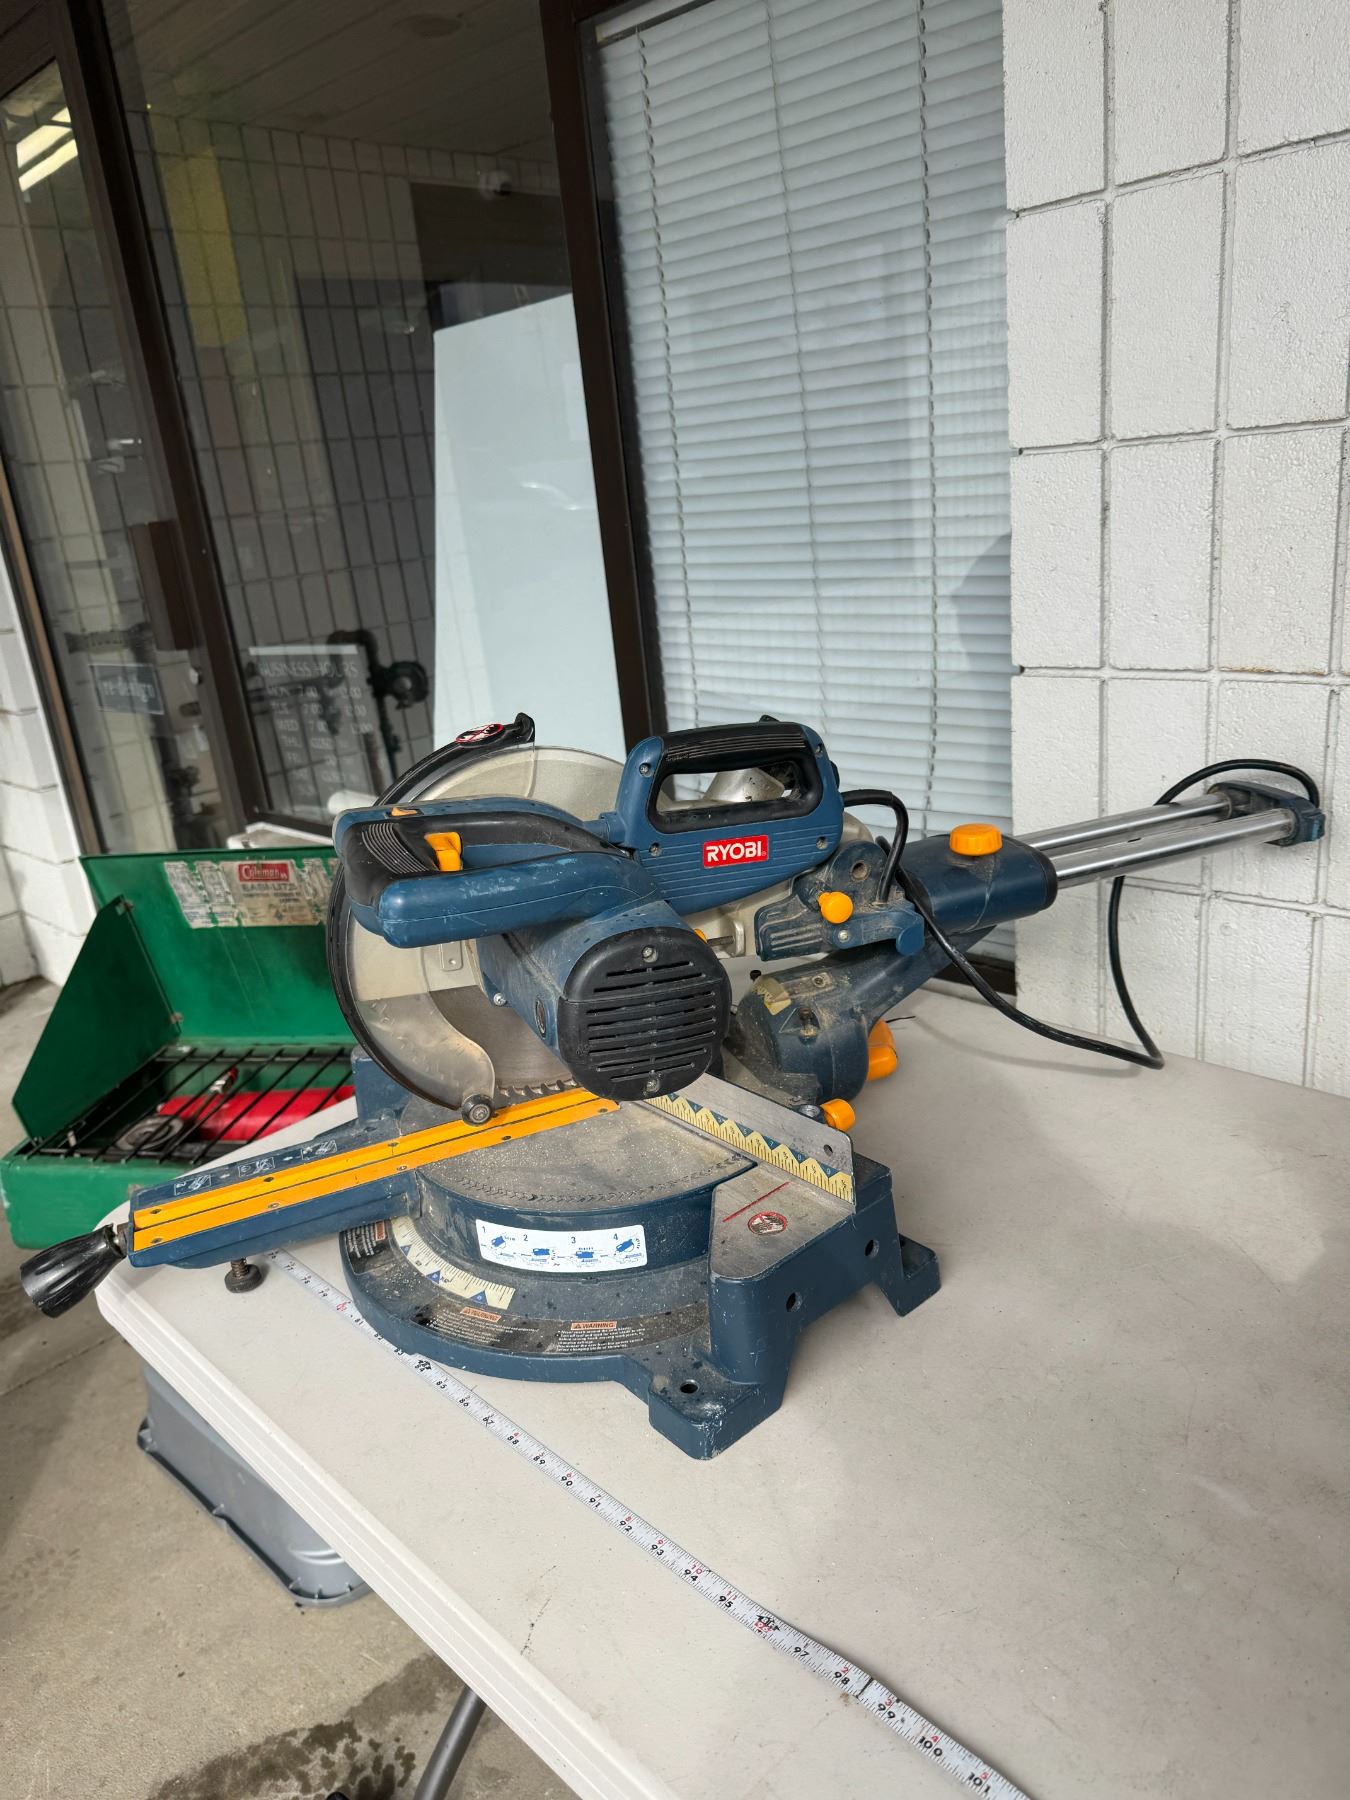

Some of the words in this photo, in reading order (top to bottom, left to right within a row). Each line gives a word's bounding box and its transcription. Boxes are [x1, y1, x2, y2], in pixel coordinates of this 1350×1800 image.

[258, 661, 312, 677] BUSINESS
[312, 661, 359, 677] HOURS
[705, 841, 762, 862] RYOBI
[482, 1225, 486, 1233] 1
[523, 1234, 529, 1242] 2
[571, 1236, 577, 1244] 3
[613, 1233, 619, 1241] 4
[436, 1380, 448, 1389] 85
[459, 1398, 469, 1407] 86
[533, 1455, 546, 1465] 89
[561, 1475, 573, 1487] 90
[589, 1497, 601, 1508] 91
[619, 1520, 633, 1532] 92
[651, 1544, 664, 1556] 93
[691, 1564, 703, 1575] 10
[684, 1569, 698, 1582] 94
[719, 1595, 733, 1608] 95
[793, 1646, 809, 1657] 97
[834, 1671, 850, 1685] 98
[877, 1703, 896, 1719] 99
[931, 1735, 940, 1743] 4
[918, 1736, 943, 1757] 100
[979, 1772, 989, 1780] 5
[968, 1772, 991, 1793] 101
